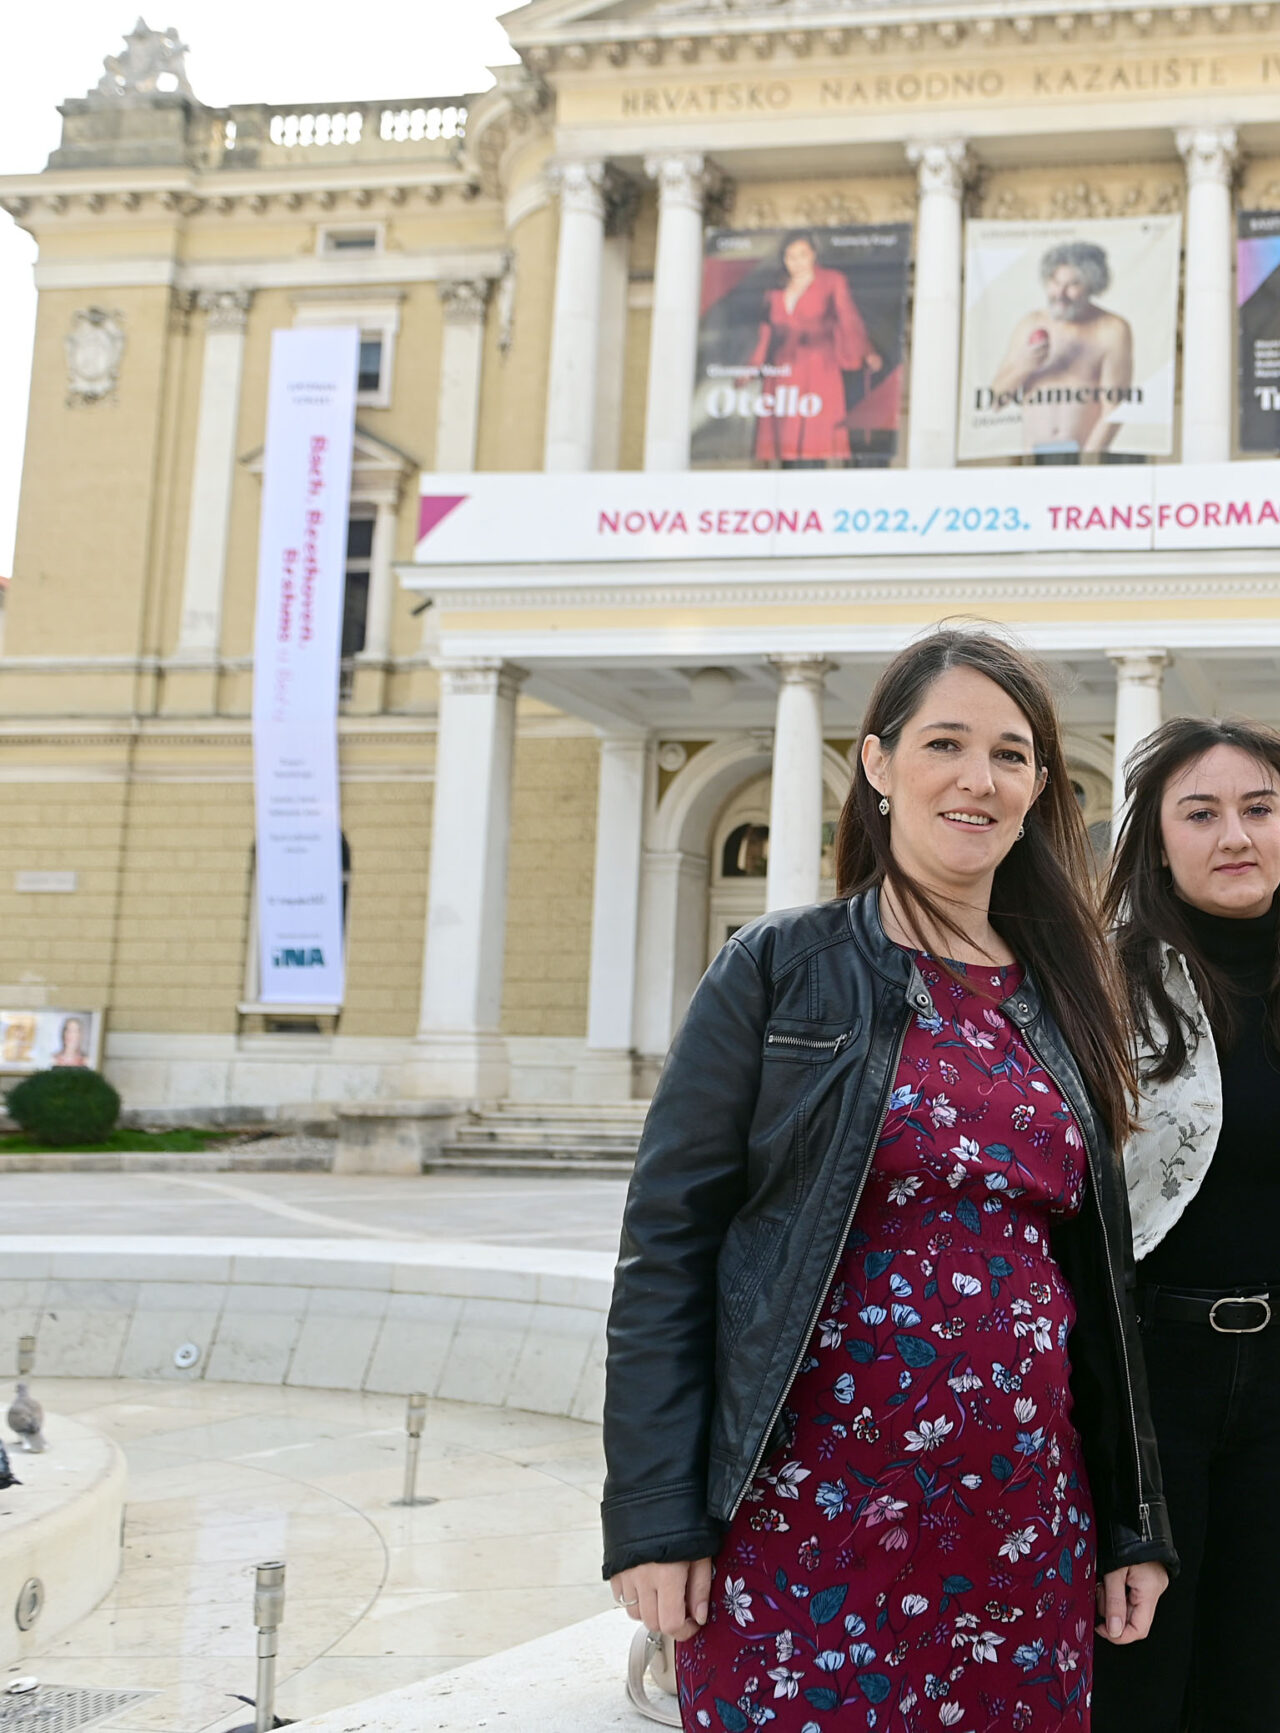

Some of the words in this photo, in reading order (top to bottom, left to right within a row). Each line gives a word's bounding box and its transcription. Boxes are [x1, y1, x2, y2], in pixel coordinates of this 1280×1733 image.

[621, 80, 792, 117] HRVATSKO
[818, 69, 1004, 106] NARODNO
[706, 384, 823, 419] Otello
[598, 509, 688, 534] NOVA
[698, 509, 823, 534] SEZONA
[833, 506, 1031, 536] 2022./2023.
